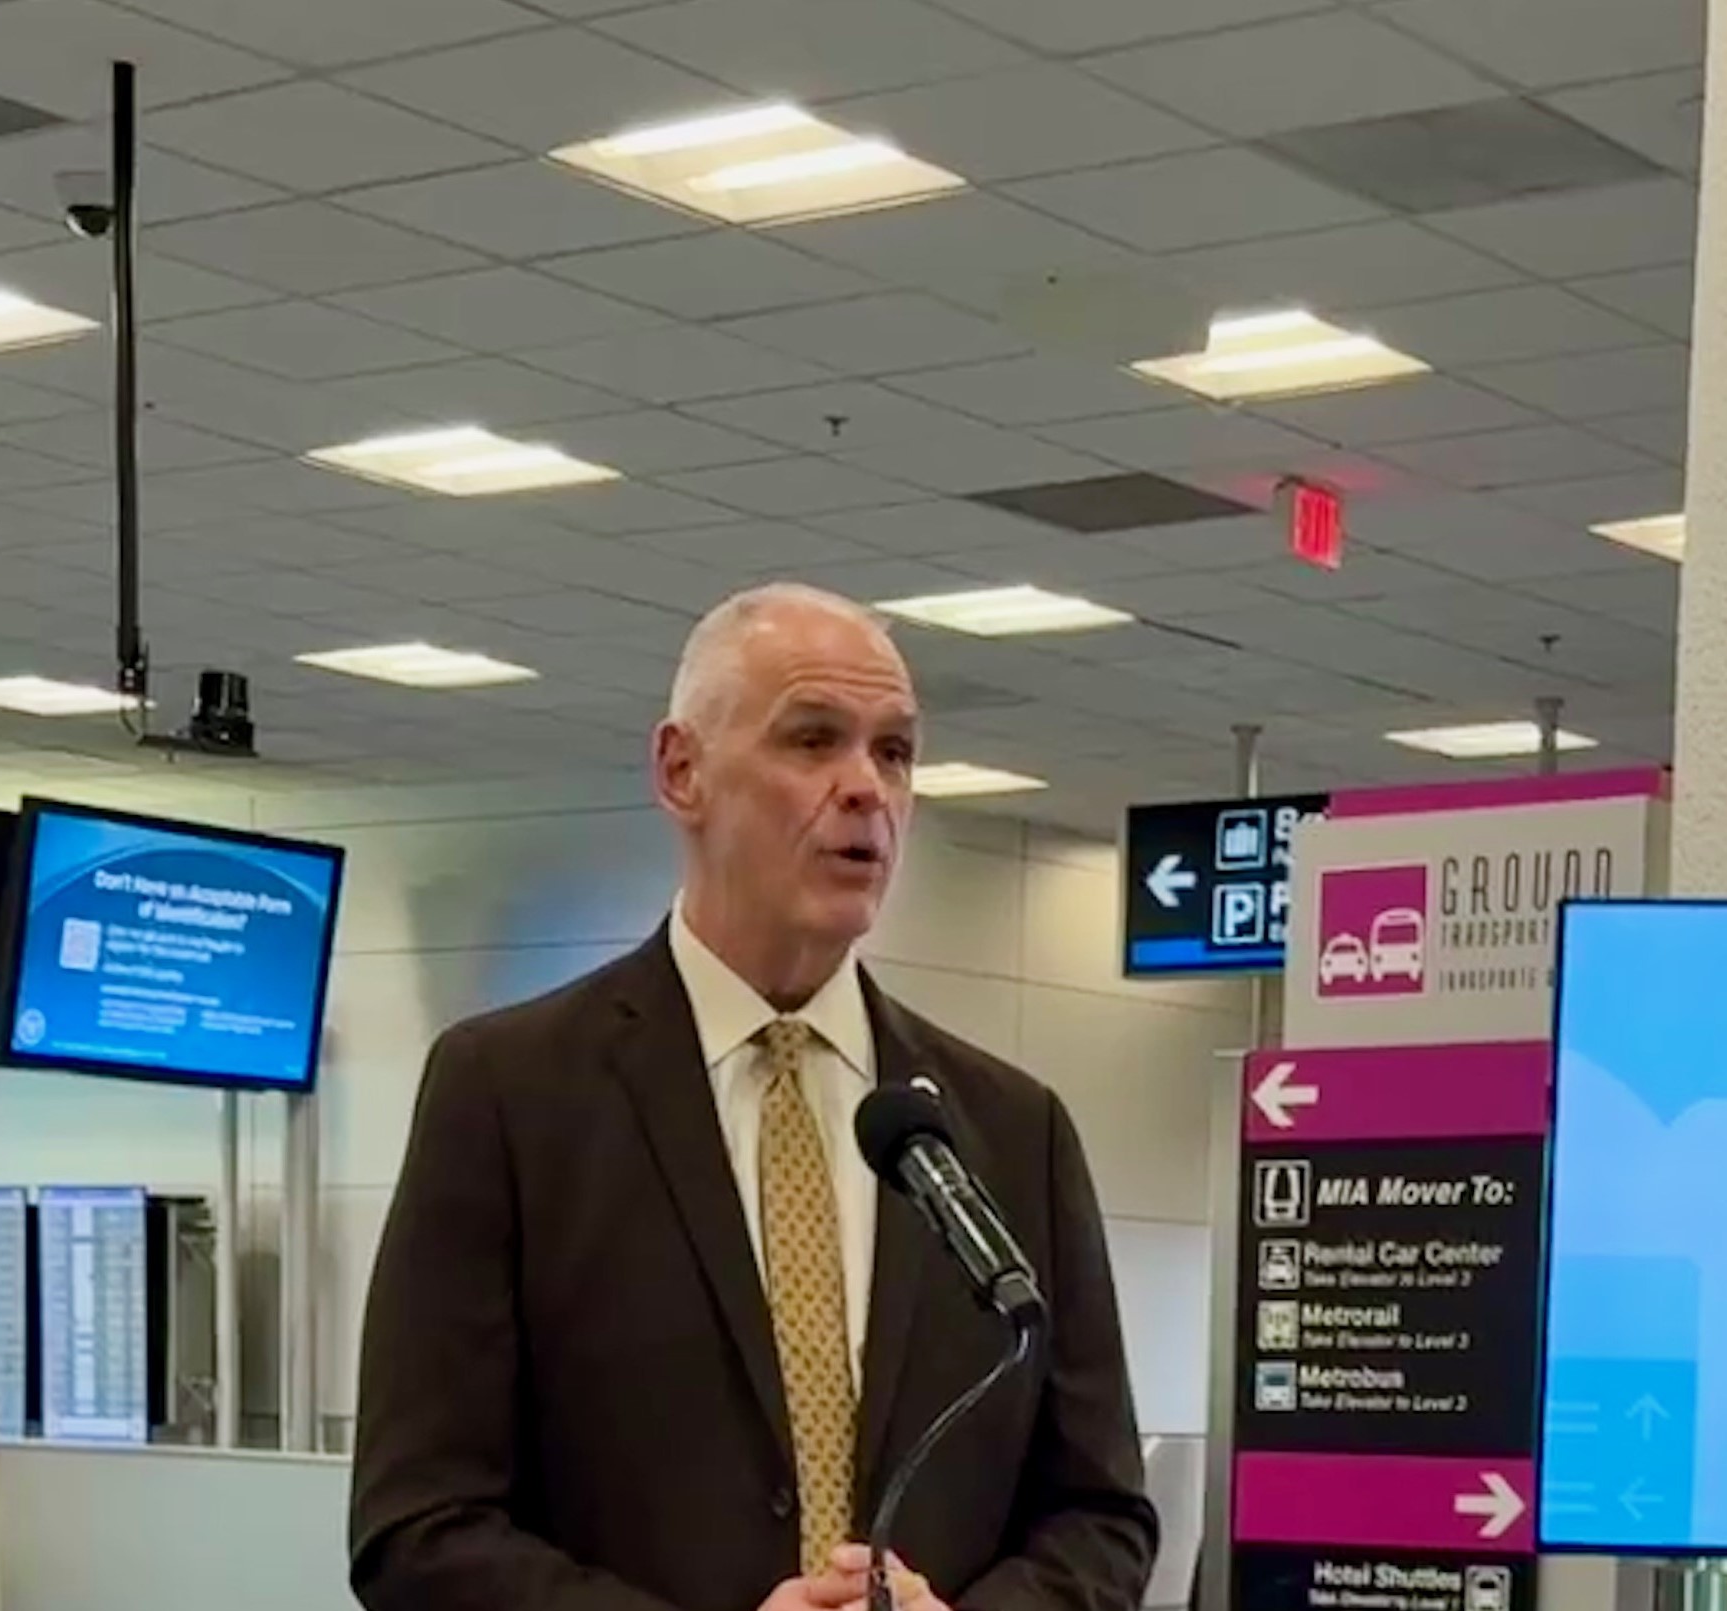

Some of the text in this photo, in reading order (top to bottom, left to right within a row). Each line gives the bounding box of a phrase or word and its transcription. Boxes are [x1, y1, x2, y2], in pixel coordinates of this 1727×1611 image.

[1442, 846, 1611, 915] GROUND
[1441, 918, 1549, 947] TRANSPORT
[1316, 1174, 1514, 1206] MIA Mover To:
[1303, 1240, 1503, 1267] Rental Car Center
[1301, 1303, 1401, 1326] Metrorail
[1299, 1365, 1405, 1389] Metrobus
[1314, 1560, 1371, 1585] Hotel
